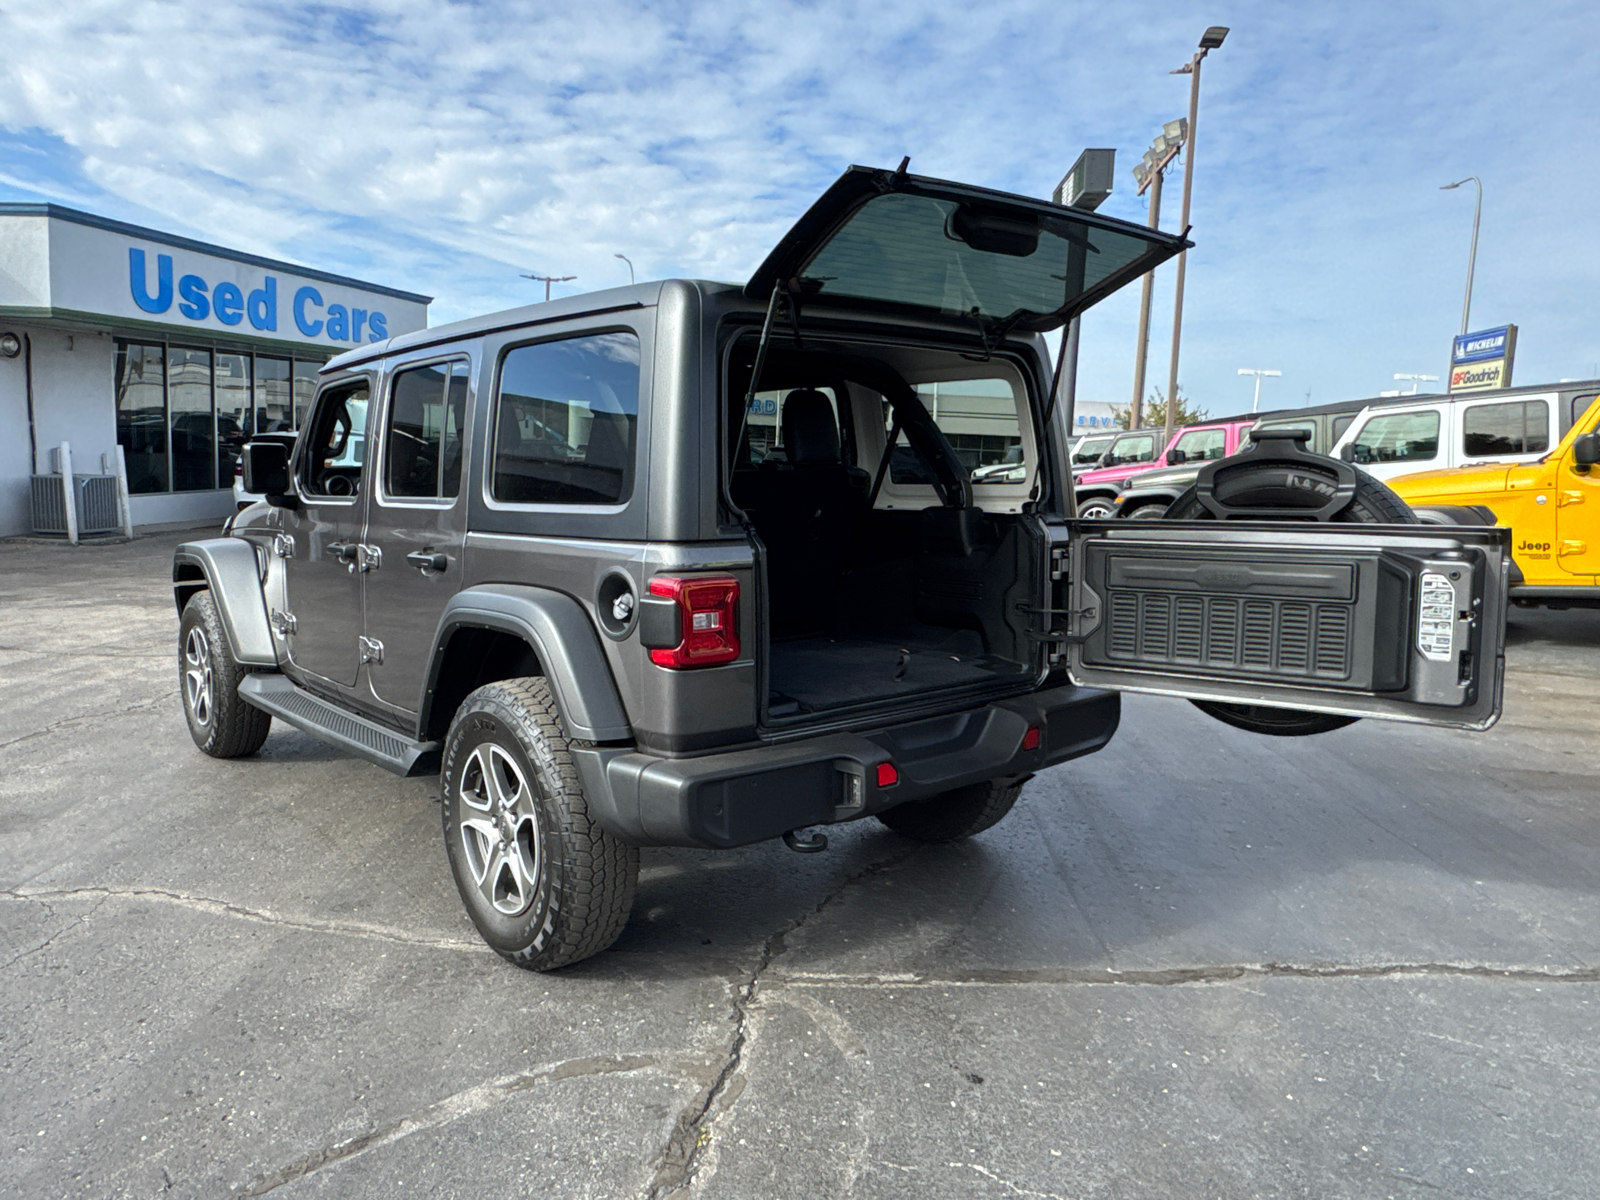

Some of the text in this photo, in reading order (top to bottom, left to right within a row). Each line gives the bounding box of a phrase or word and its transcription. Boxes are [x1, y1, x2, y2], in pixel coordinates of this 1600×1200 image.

[129, 248, 388, 343] Used Cars
[1466, 336, 1504, 352] MICHELIN
[1452, 366, 1500, 386] BFGoodrich
[751, 399, 776, 414] RD
[1517, 540, 1551, 552] Jeep
